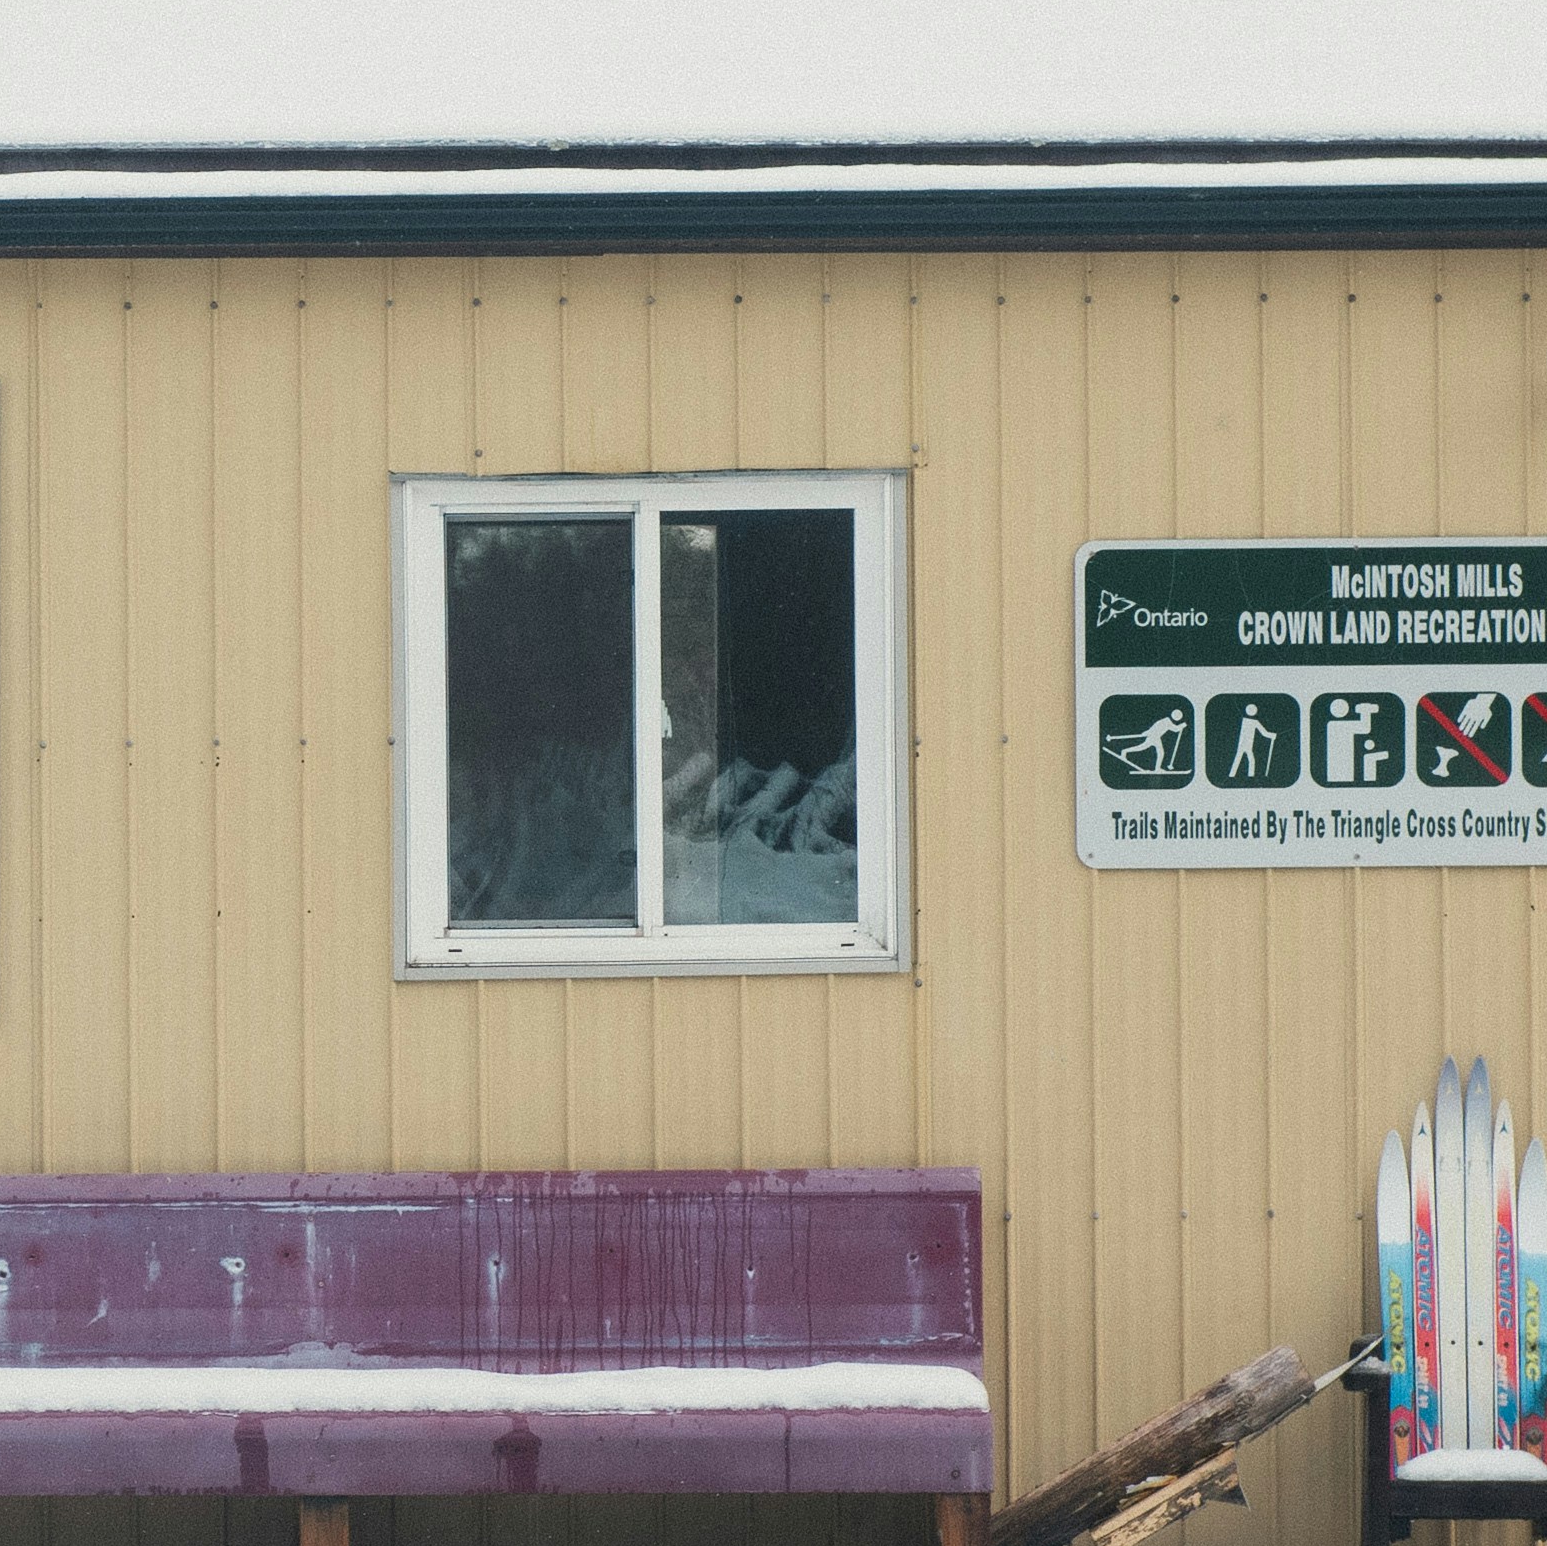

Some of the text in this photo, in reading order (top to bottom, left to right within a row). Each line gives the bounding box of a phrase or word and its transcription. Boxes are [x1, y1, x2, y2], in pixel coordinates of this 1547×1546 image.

[1331, 563, 1524, 599] McINTOSH MILLS
[1133, 606, 1209, 628] Ontario
[1238, 610, 1324, 646] CROWN
[1330, 610, 1391, 645] LAND
[1397, 608, 1546, 644] RECREATION
[1111, 811, 1159, 840] Trails
[1164, 810, 1261, 840] Maintained
[1266, 810, 1288, 846] By
[1292, 809, 1326, 839] The
[1330, 809, 1401, 845] Triangle
[1406, 808, 1457, 838] Cross
[1461, 808, 1531, 844] Country
[1416, 1225, 1432, 1332] ATOMIC
[1498, 1224, 1513, 1330] ATOMIC
